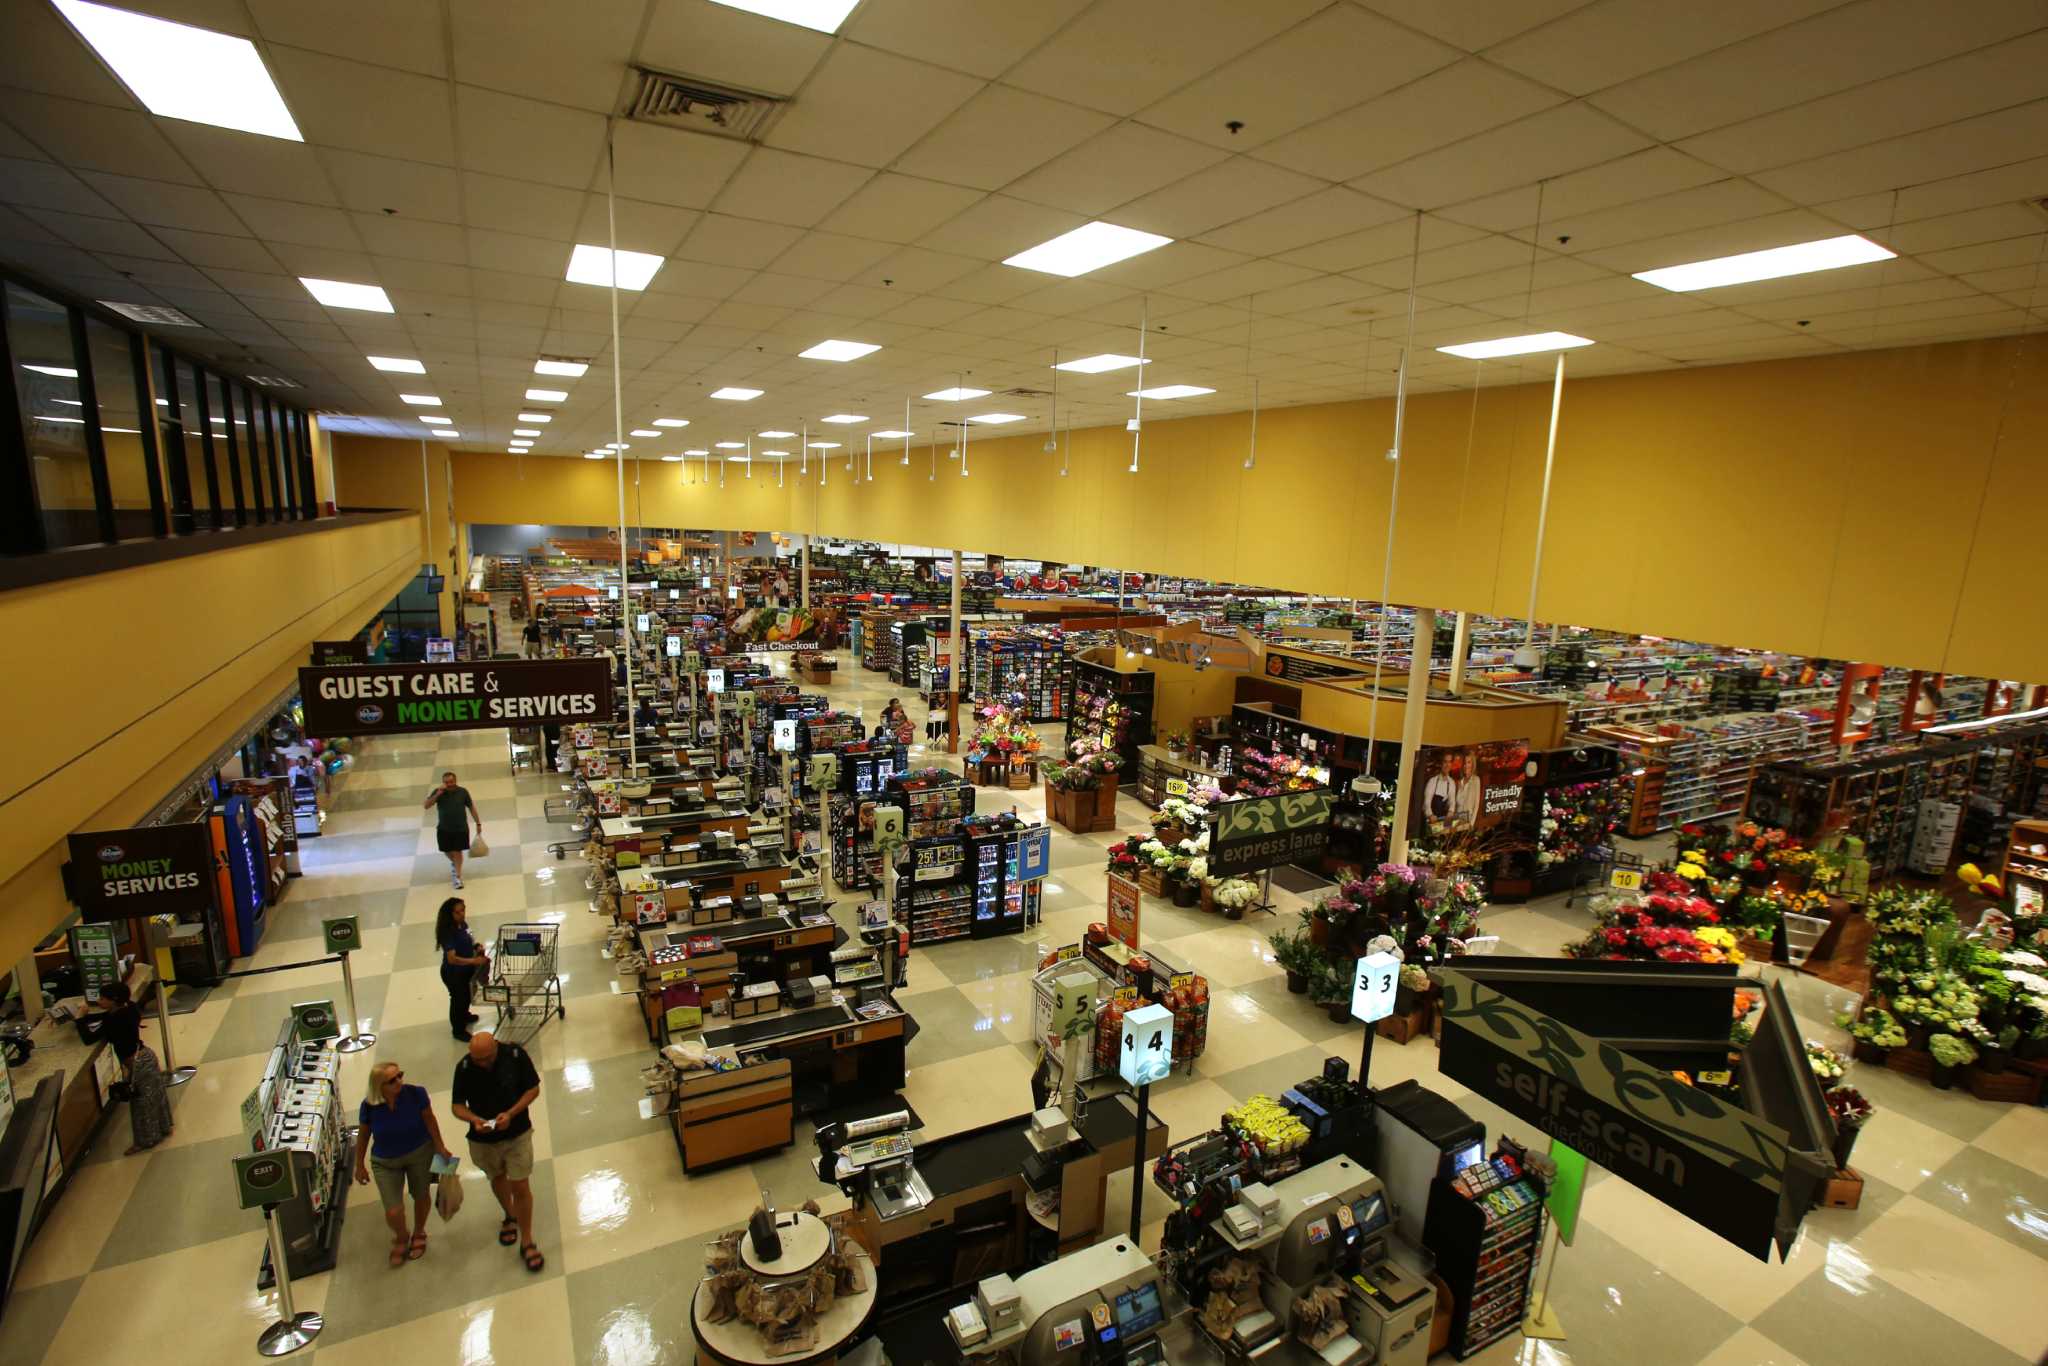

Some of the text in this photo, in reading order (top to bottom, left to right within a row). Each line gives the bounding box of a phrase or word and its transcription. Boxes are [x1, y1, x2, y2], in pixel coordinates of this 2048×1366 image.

[745, 641, 819, 652] Fast Checkout
[319, 671, 499, 700] GUEST CARE &
[711, 674, 722, 682] 10
[397, 699, 484, 724] MONEY
[489, 693, 597, 719] SERVICES
[742, 697, 750, 706] 9
[782, 727, 790, 737] 8
[822, 762, 831, 774] 7
[1485, 784, 1522, 800] Friendly
[1485, 799, 1518, 813] Service
[281, 814, 295, 841] Hello
[885, 819, 895, 832] 6
[1223, 836, 1288, 864] express
[1289, 831, 1322, 850] lane
[101, 858, 173, 880] MONEY
[104, 872, 200, 897] SERVICES
[1359, 974, 1369, 991] 3
[1380, 974, 1392, 993] 3
[1056, 994, 1063, 1009] 5
[1076, 995, 1088, 1014] 5
[1124, 1033, 1134, 1051] 4
[1147, 1030, 1163, 1051] 4
[1494, 1060, 1686, 1188] self-scan
[254, 1165, 274, 1175] EXIT
